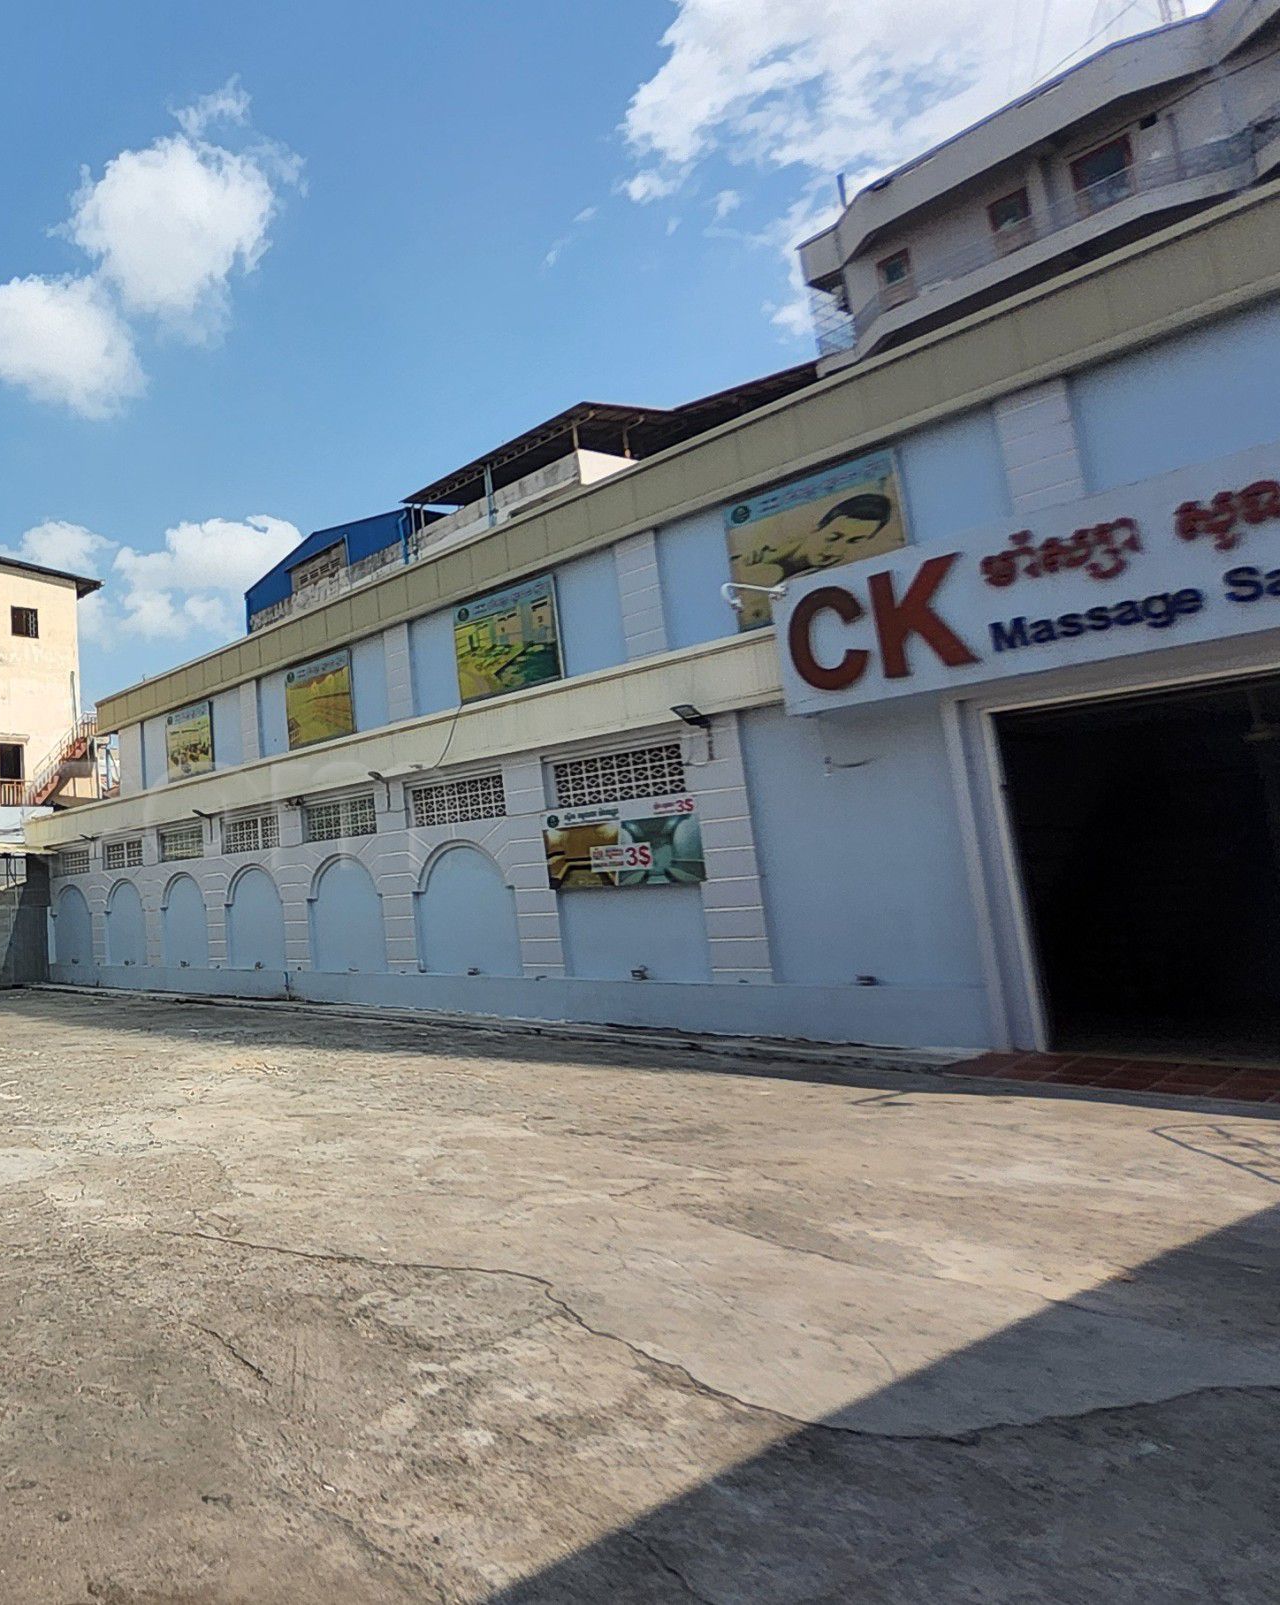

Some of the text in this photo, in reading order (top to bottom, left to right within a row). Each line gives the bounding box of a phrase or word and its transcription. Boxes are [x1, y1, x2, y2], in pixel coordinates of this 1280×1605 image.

[788, 551, 982, 691] CK
[987, 587, 1206, 652] Massage
[624, 845, 652, 868] 3$
